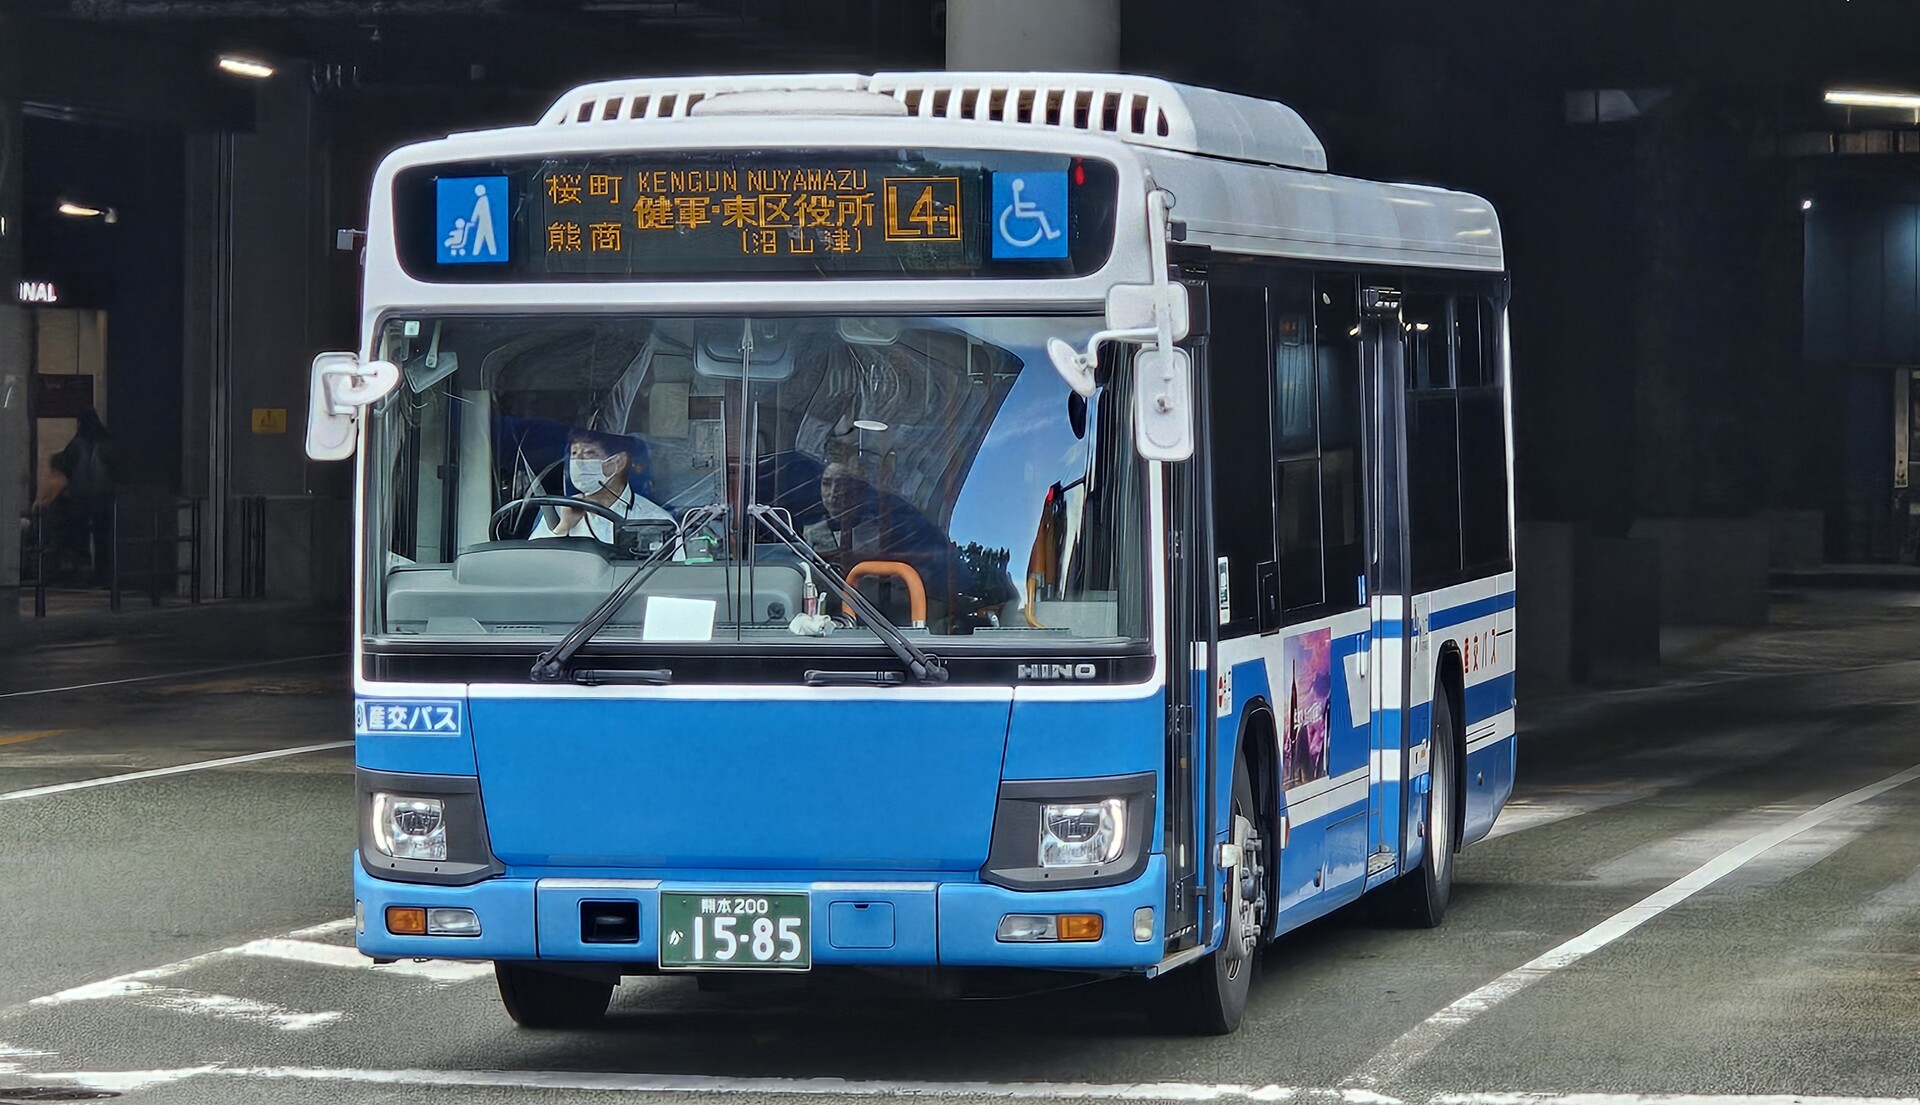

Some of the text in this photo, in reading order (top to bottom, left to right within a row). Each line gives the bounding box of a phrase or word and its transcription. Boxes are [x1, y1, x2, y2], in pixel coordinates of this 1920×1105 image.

[546, 173, 623, 204] 桜町
[637, 169, 868, 193] KENGUN NUYAMAZU
[547, 221, 622, 252] 熊商
[1017, 663, 1097, 679] HINO
[369, 705, 458, 731] 産交バス
[694, 916, 802, 962] 15-85
